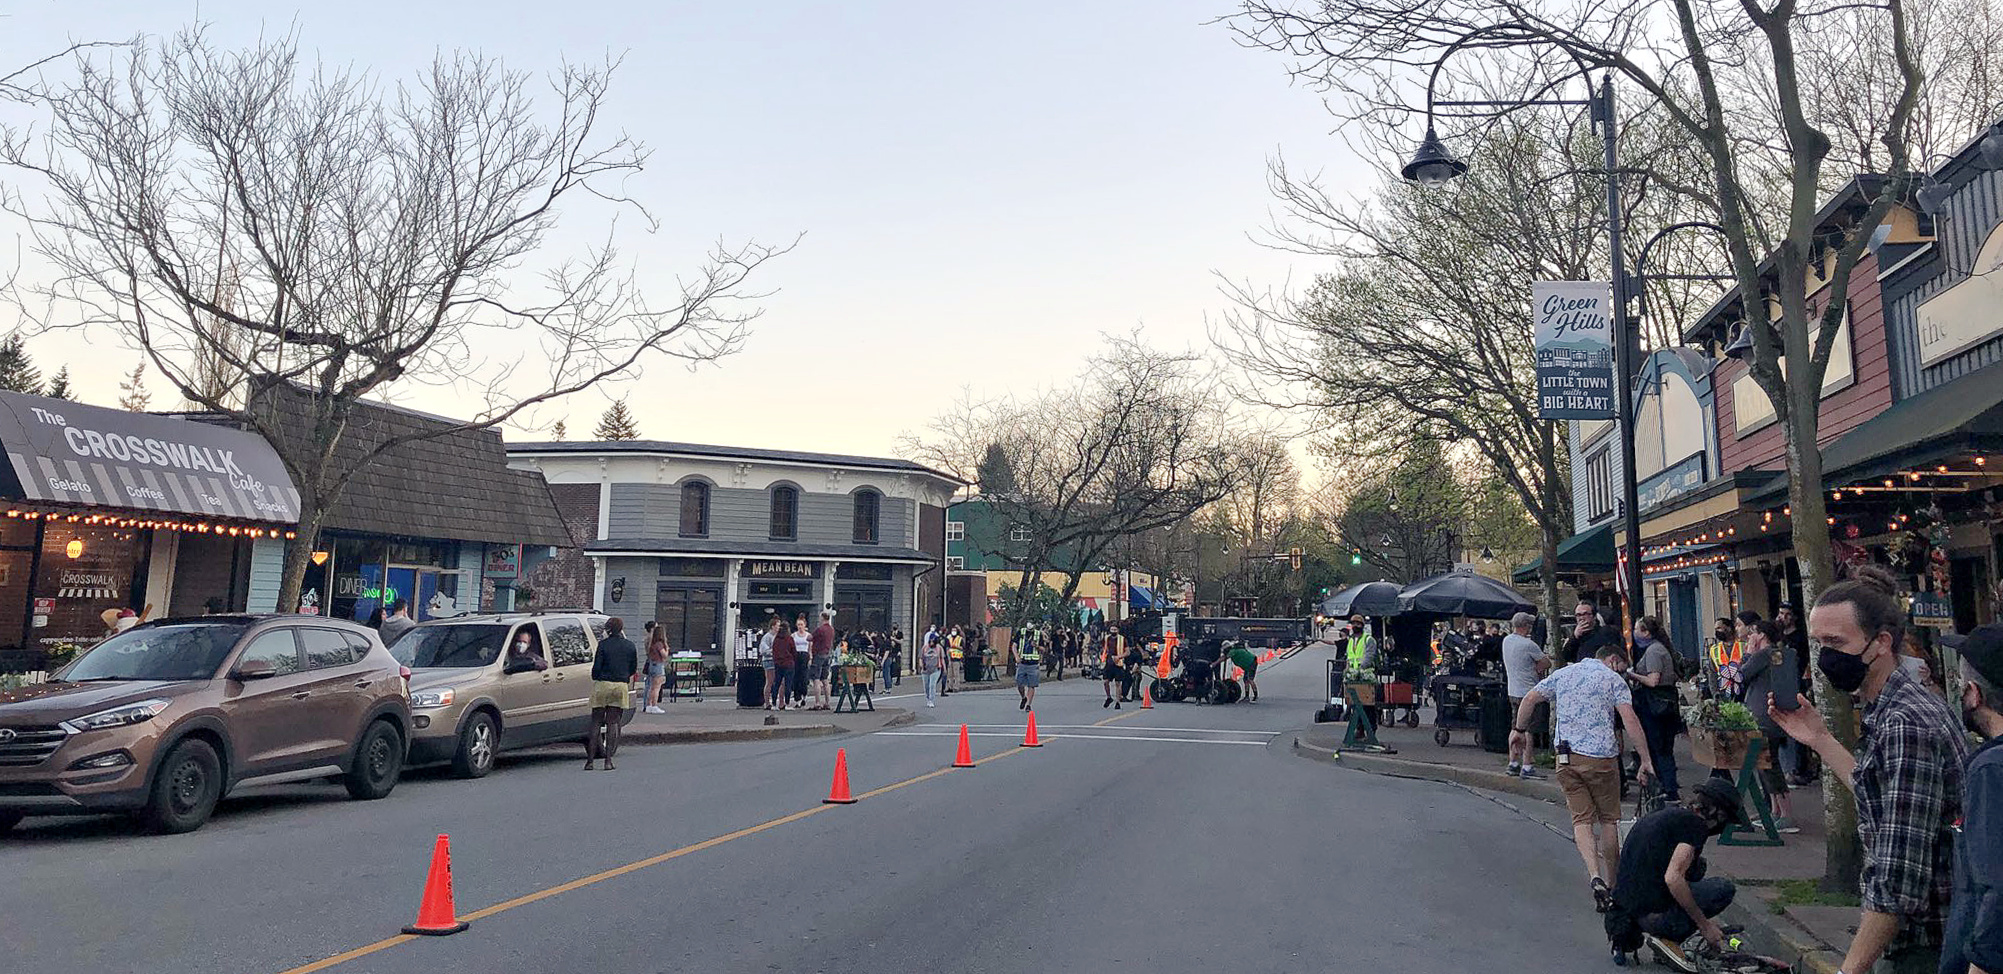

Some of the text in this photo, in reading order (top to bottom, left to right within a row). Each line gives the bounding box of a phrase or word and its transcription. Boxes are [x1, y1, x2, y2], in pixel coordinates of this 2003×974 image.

[1541, 295, 1598, 324] Green
[1554, 311, 1604, 338] Hills
[1922, 316, 1947, 347] the
[1568, 369, 1580, 377] the
[1542, 377, 1608, 388] LITTLE TOWN
[1563, 388, 1581, 396] with
[1543, 395, 1608, 410] BIG HEART
[31, 407, 66, 426] The
[63, 426, 243, 475] CROSSWALK
[229, 473, 265, 497] Cafe
[49, 477, 289, 513] Gelato Coffee Tea Snacks
[752, 562, 812, 576] MEAN BEAN
[62, 574, 114, 585] CROSSWALK
[339, 577, 368, 595] DINER
[1915, 603, 1948, 616] OPEN
